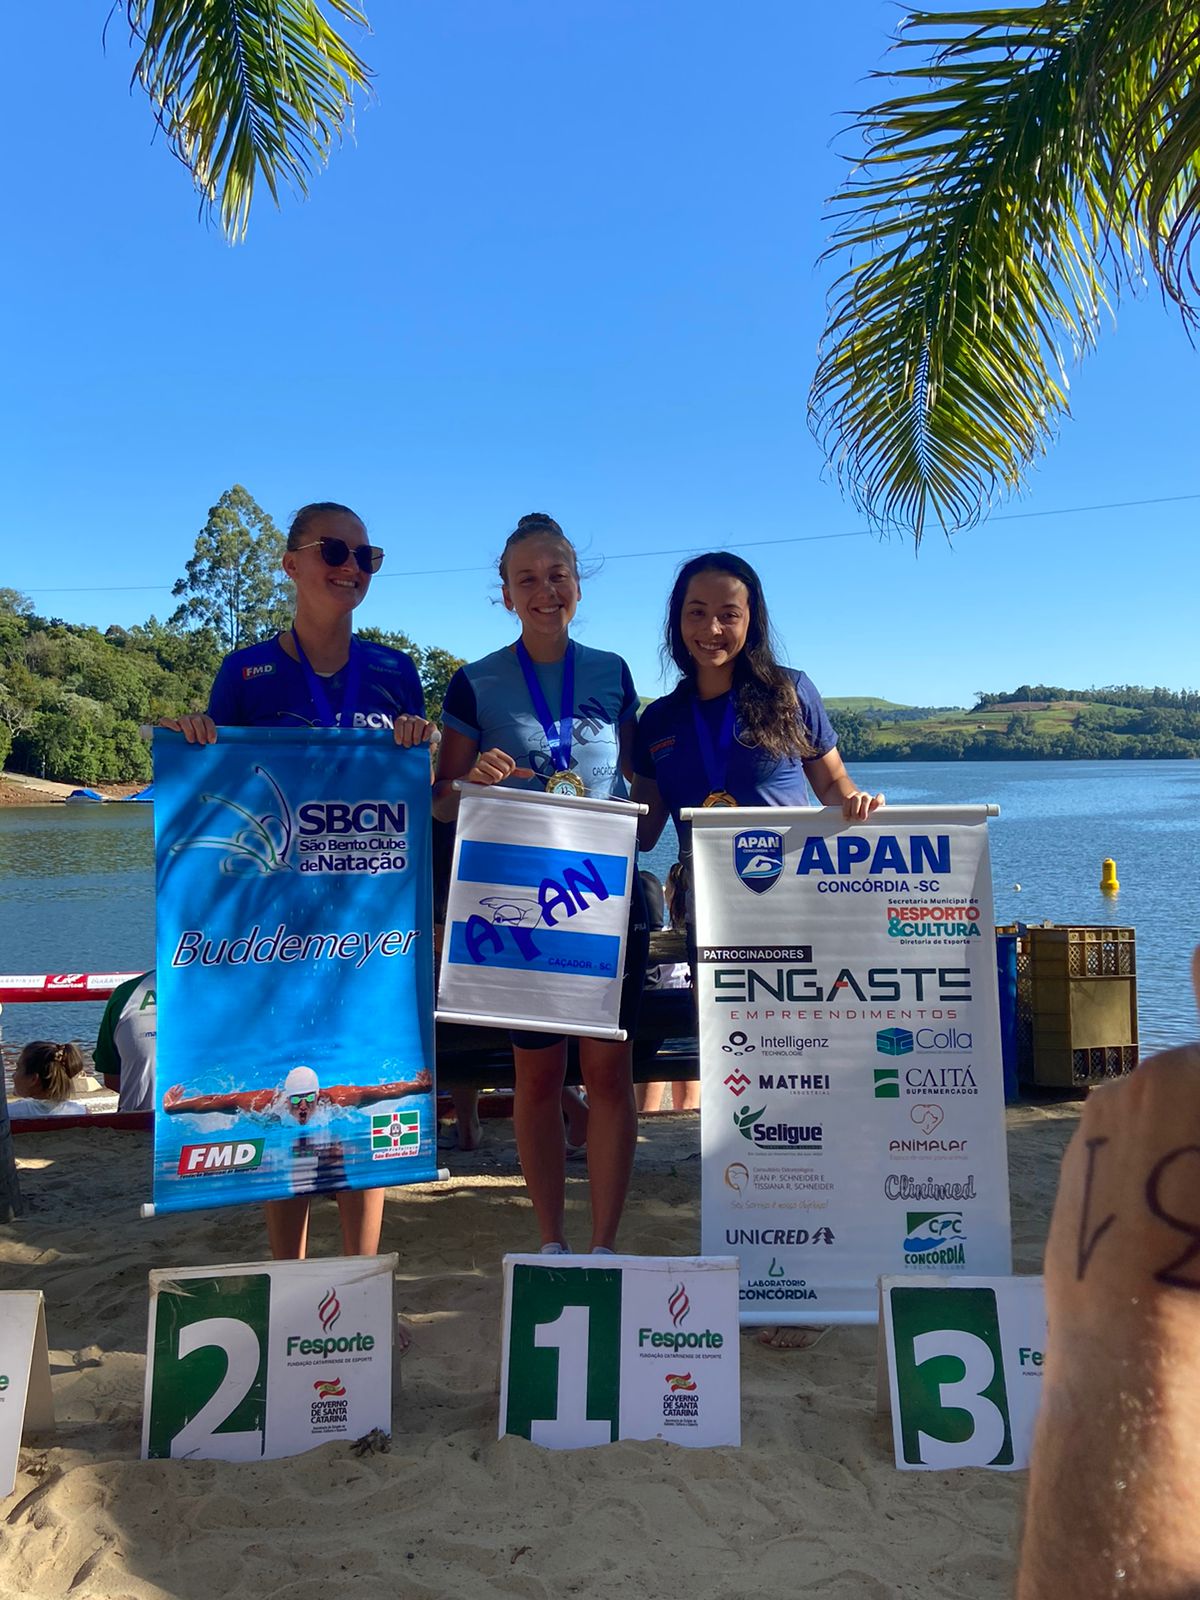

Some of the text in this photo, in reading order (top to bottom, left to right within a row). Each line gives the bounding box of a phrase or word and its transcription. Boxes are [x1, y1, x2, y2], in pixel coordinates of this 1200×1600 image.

[246, 664, 272, 677] FMD
[299, 803, 405, 835] SBCN
[300, 838, 405, 851] São Bento Clube
[737, 836, 780, 848] APAN
[796, 835, 952, 875] APAN
[817, 878, 909, 893] CONCÓRDIA
[930, 898, 967, 906] Municipal
[887, 906, 980, 920] DESPORTO
[172, 925, 419, 968] Buddemeyer
[703, 949, 804, 960] PATROCINADORES
[548, 957, 592, 969] CAÇADOR
[600, 962, 612, 970] SC
[714, 968, 972, 1003] ENGASTE
[730, 1009, 957, 1020] EMPREENDIMENTOS
[760, 1036, 829, 1050] Intelligenz
[916, 1028, 973, 1049] Colla
[759, 1075, 830, 1089] MATHEI
[905, 1064, 977, 1087] CAITÁ
[753, 1123, 823, 1144] Seligue
[188, 1143, 257, 1170] FMD
[884, 1174, 977, 1201] Clinimed
[929, 1219, 962, 1236] CPC
[726, 1229, 810, 1245] UNICRED
[748, 1279, 806, 1287] LABORATÓRIO
[739, 1287, 818, 1300] CONCÓRDIA
[286, 1332, 375, 1359] Fesporte
[638, 1328, 724, 1352] Fesporte
[531, 1306, 611, 1450] 1
[171, 1317, 262, 1461] 2
[311, 1400, 348, 1409] GOVERNO
[663, 1394, 699, 1402] GOVERNO
[663, 1401, 699, 1409] DE SANTA
[912, 1330, 1006, 1468] 3
[311, 1407, 348, 1417] DE SANTA
[310, 1415, 348, 1424] CATARINA
